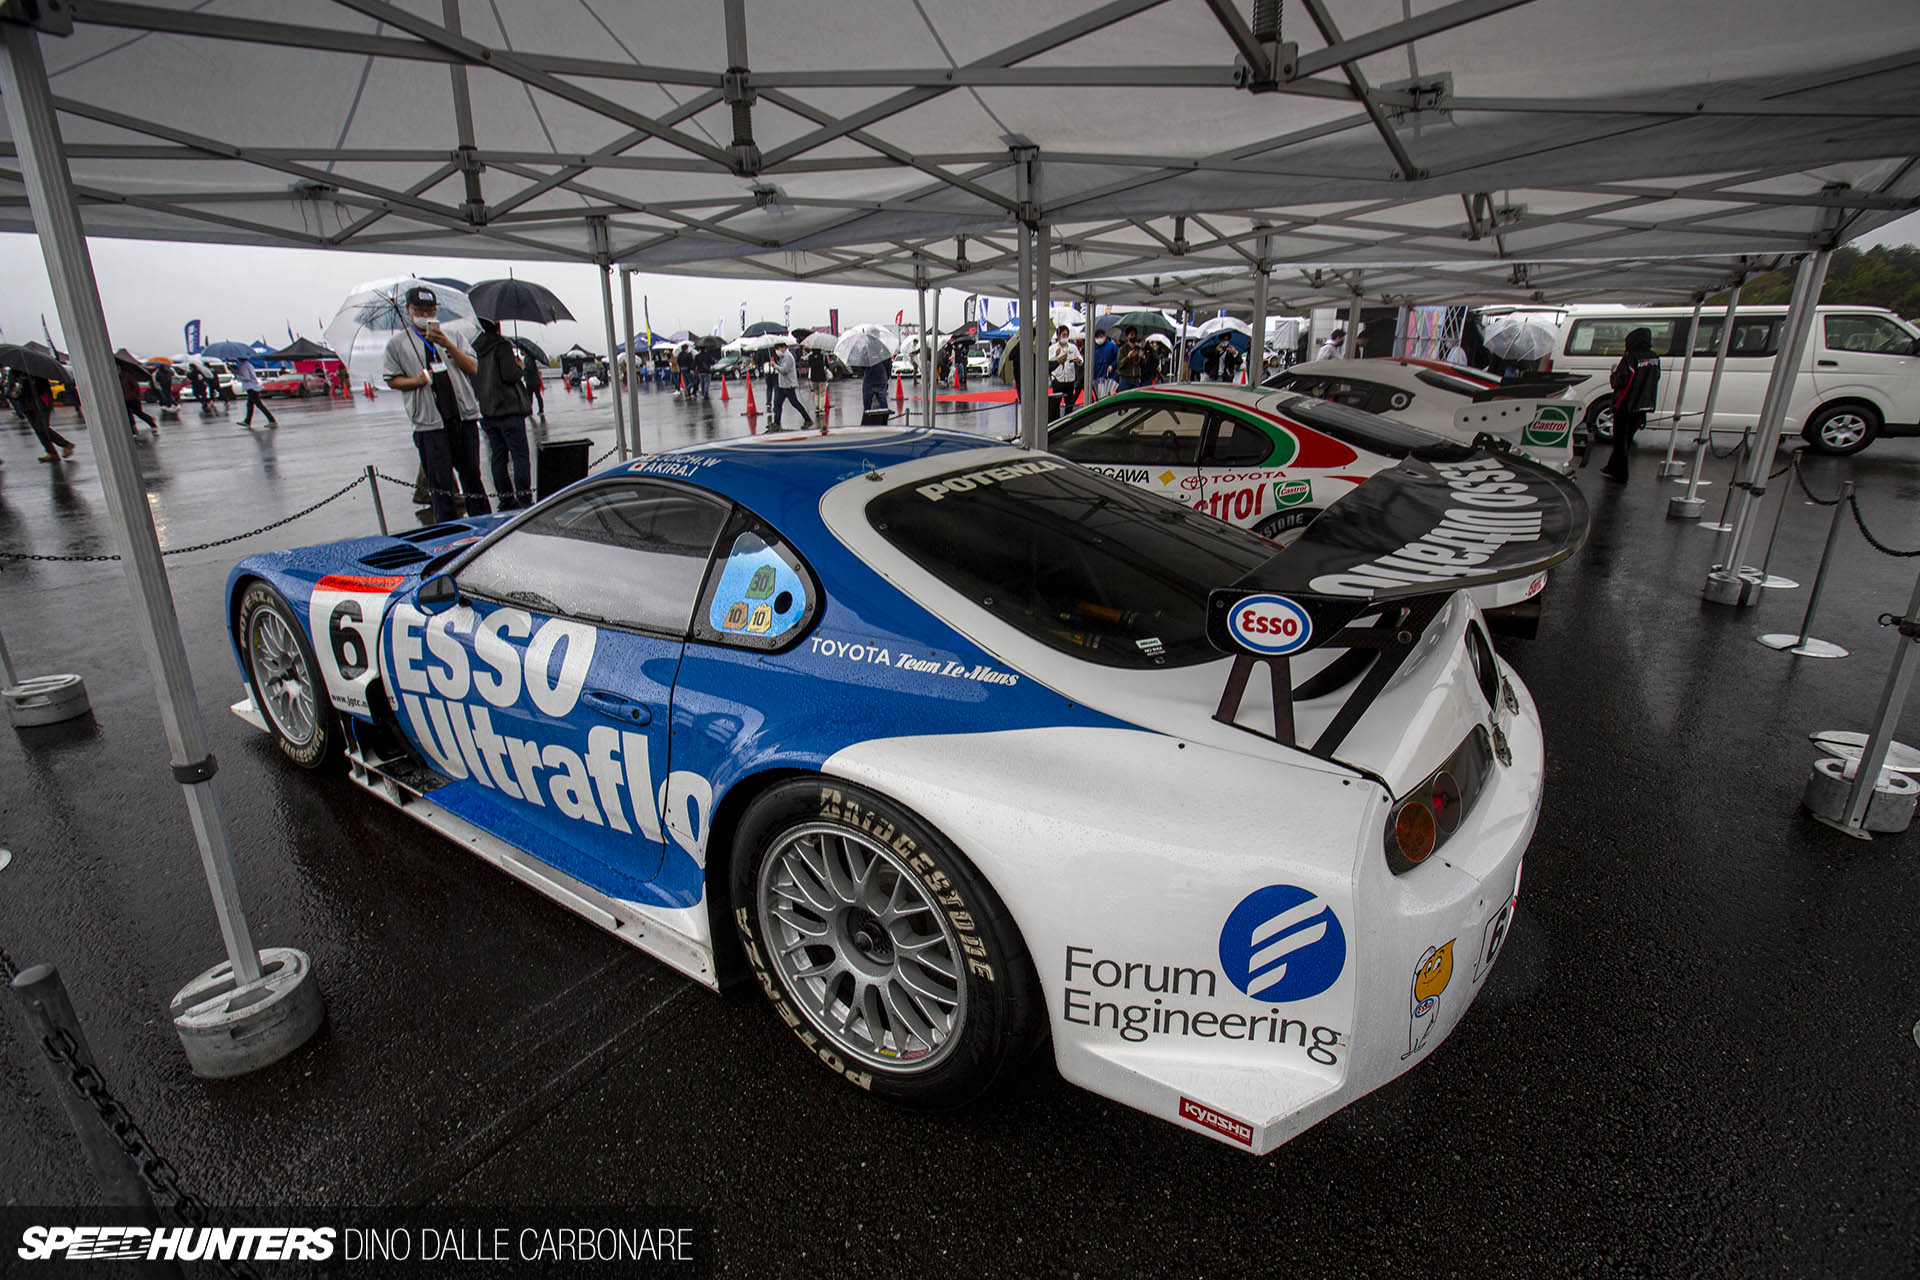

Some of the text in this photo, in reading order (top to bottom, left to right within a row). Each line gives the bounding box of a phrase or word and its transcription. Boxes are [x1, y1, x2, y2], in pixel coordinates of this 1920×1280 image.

[1532, 419, 1567, 431] Castrol
[915, 460, 1066, 502] POTENZA
[1088, 467, 1149, 483] GAWA
[1211, 471, 1286, 484] TOYOTA
[1280, 485, 1307, 496] Castrol
[1430, 457, 1538, 508] ESSO
[1261, 513, 1304, 538] STONE
[750, 574, 769, 592] 30
[728, 608, 741, 624] 10
[752, 611, 766, 626] 10
[1241, 610, 1298, 637] Esso
[329, 599, 369, 681] 6
[392, 602, 597, 718] ESSO
[811, 637, 890, 666] TOYOTA
[894, 652, 942, 676] Team
[963, 665, 1020, 687] Mans
[402, 693, 713, 870] Ultraflo
[818, 786, 996, 983] BRIDGESTONE
[1486, 906, 1508, 964] 6
[1065, 945, 1216, 997] Forum
[735, 906, 873, 1092] POTENZA
[1063, 987, 1342, 1066] Engineering
[1185, 1102, 1250, 1139] KYOSHO
